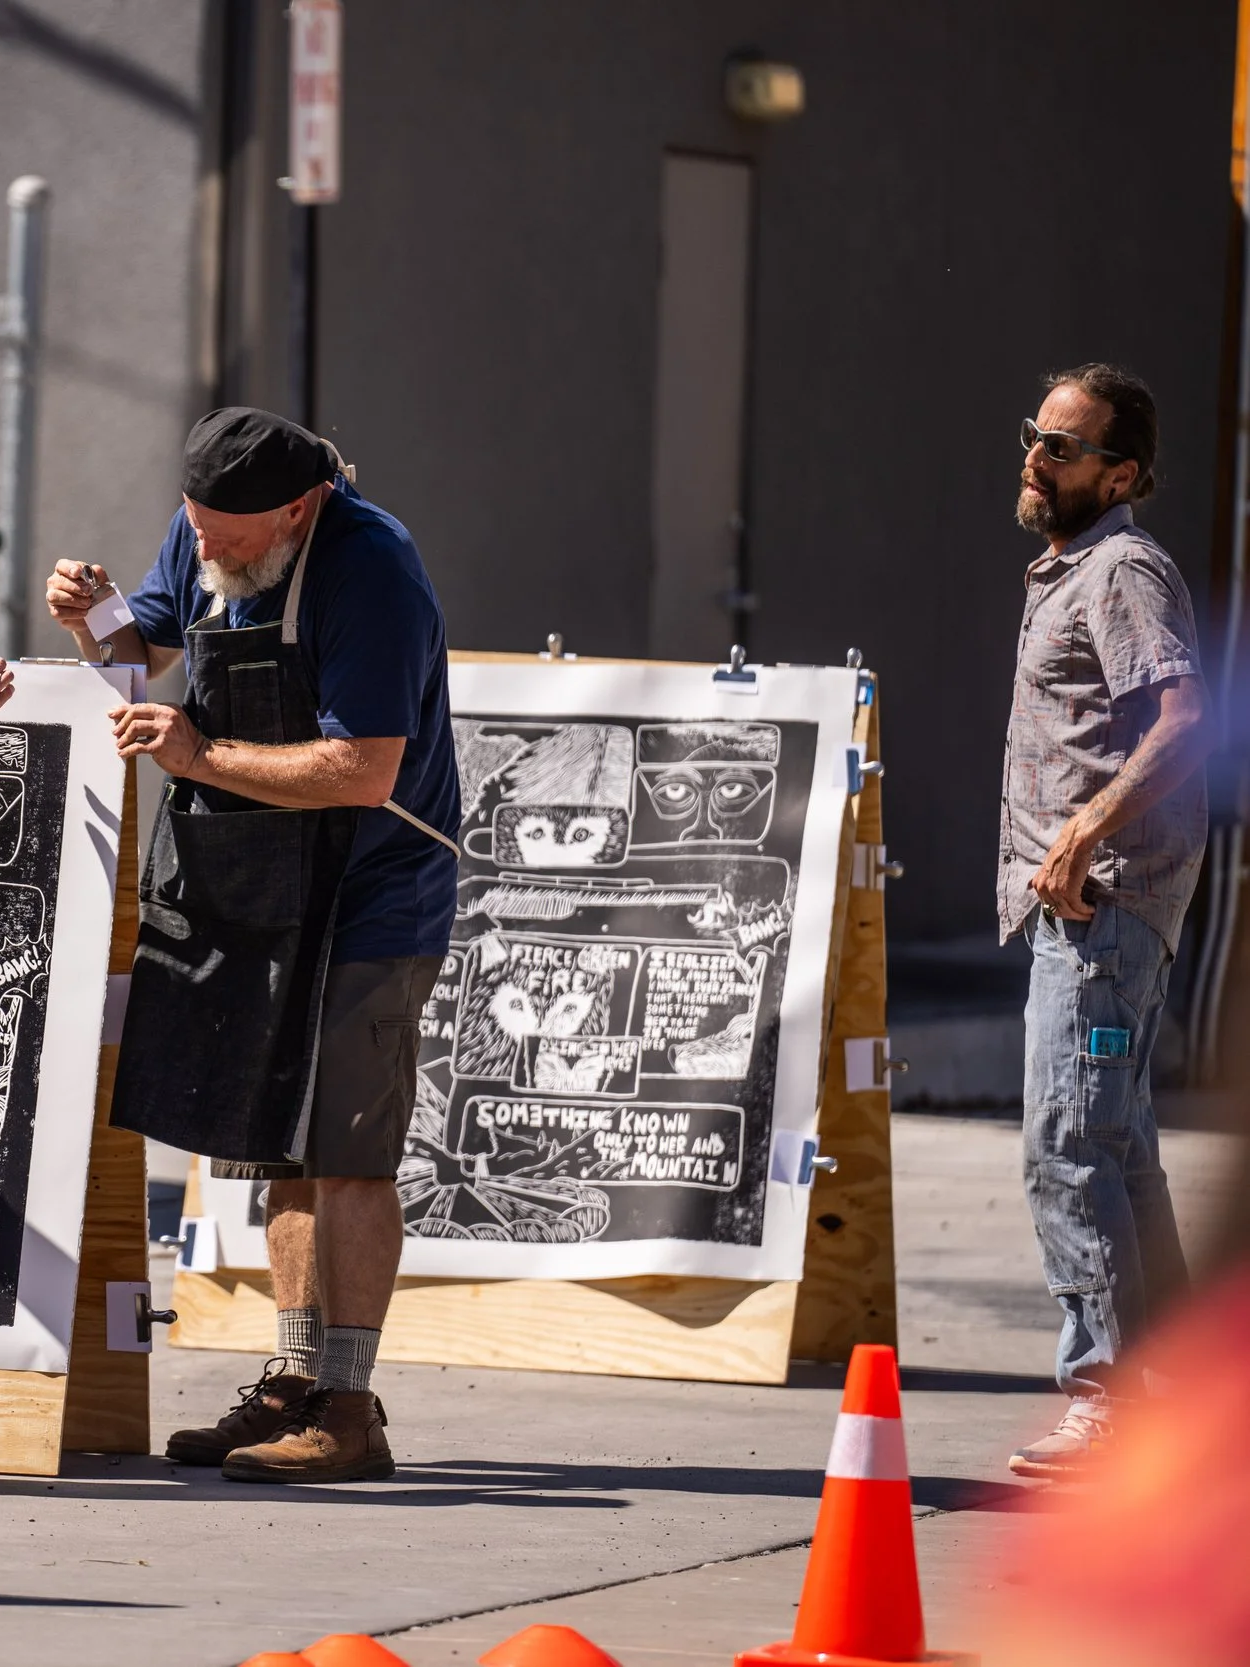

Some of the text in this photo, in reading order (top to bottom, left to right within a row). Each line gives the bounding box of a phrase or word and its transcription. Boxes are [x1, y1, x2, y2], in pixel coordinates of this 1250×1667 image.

[650, 951, 665, 968] I
[529, 970, 587, 996] FIRE
[476, 1102, 690, 1133] SOMETHING KNOWN
[593, 1133, 725, 1155] ONLY TO HER AND
[600, 1146, 737, 1184] THE MOUNTAIN
